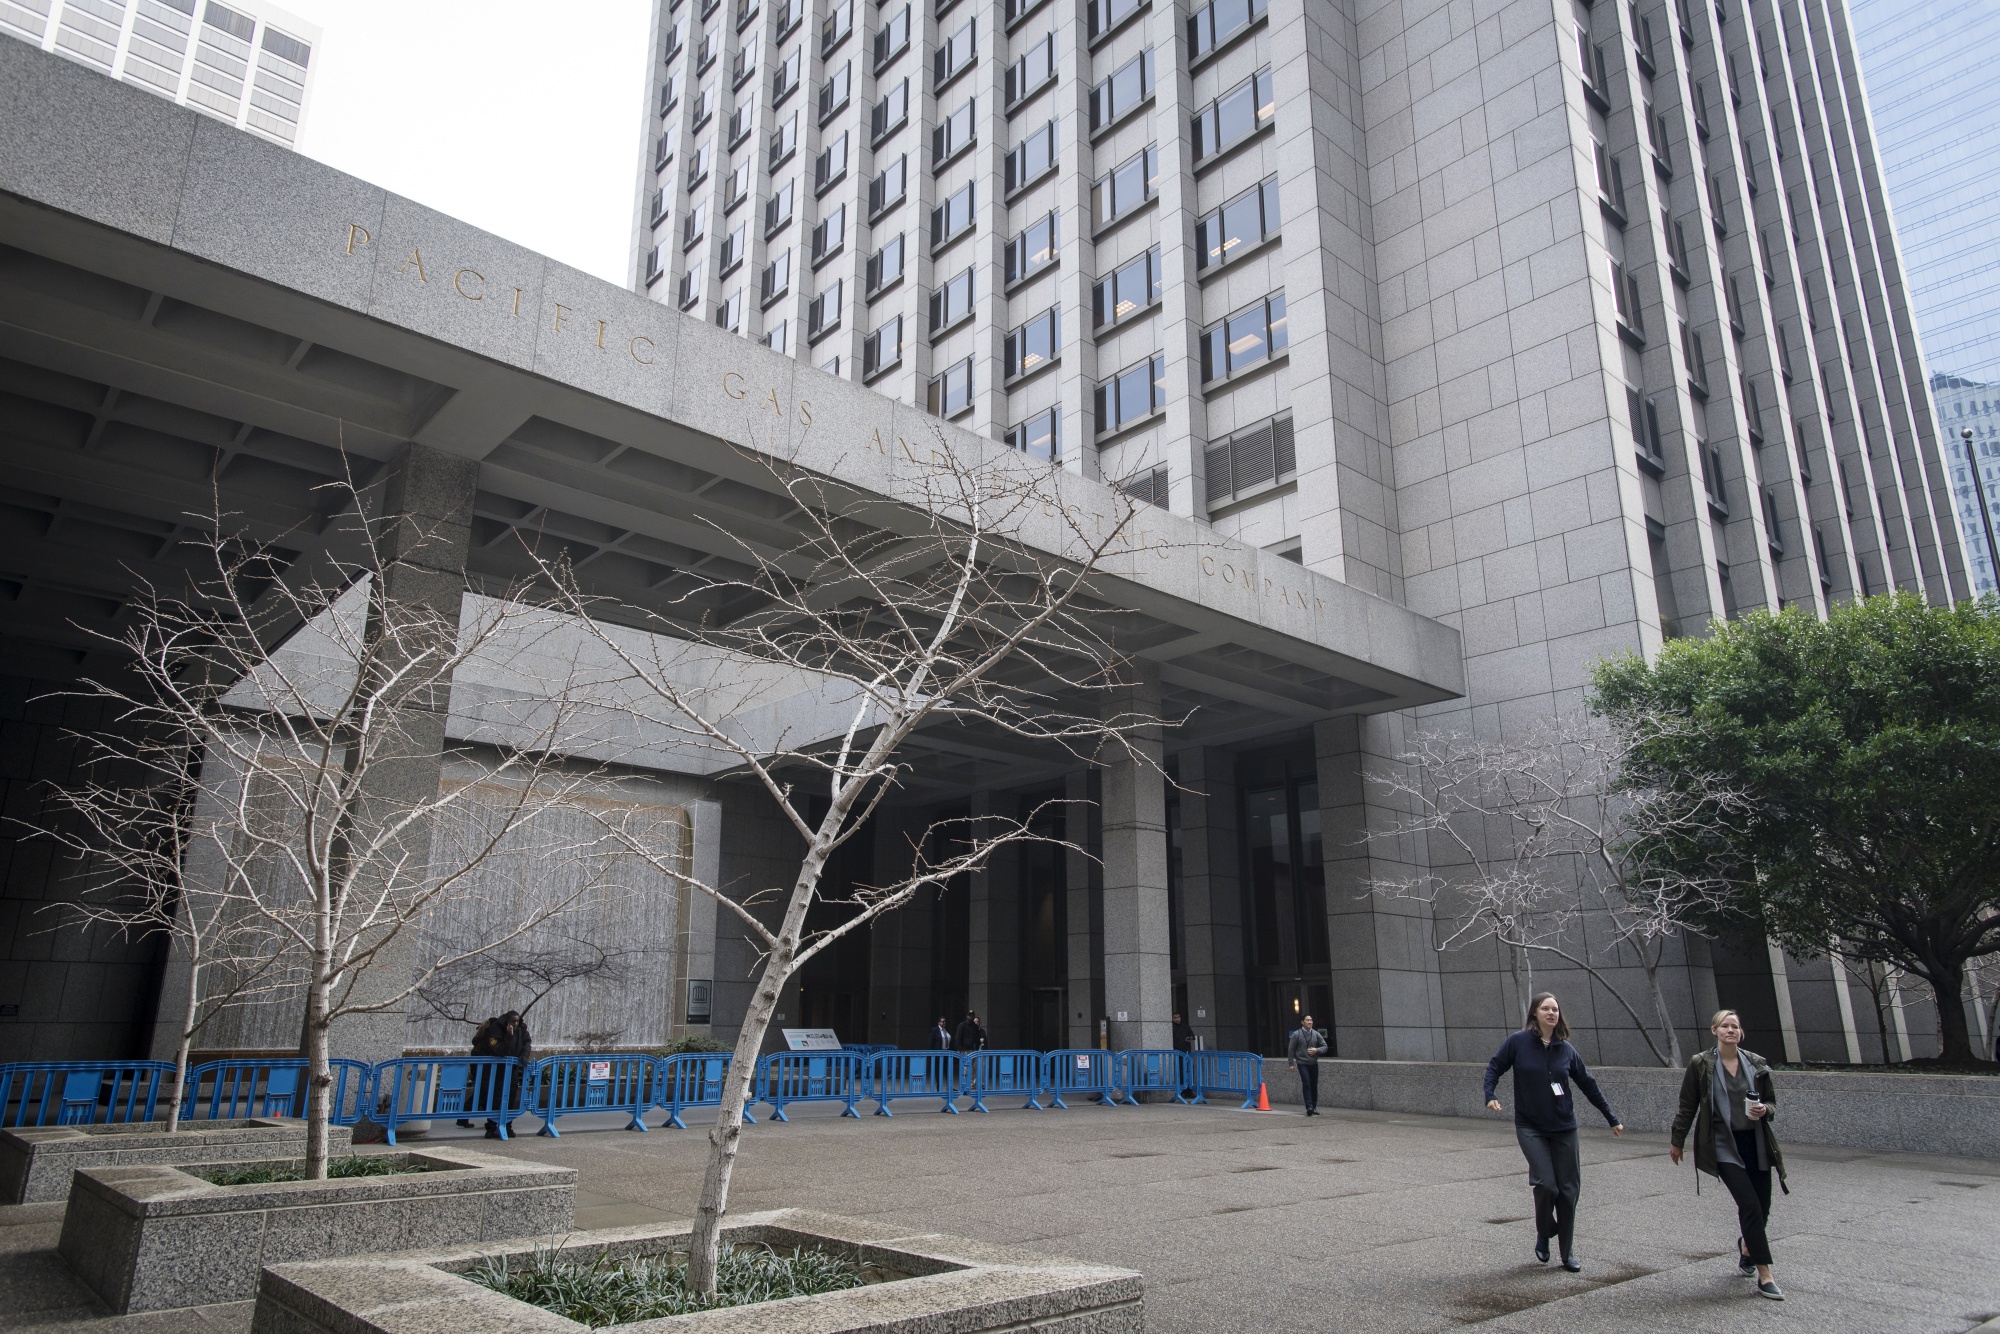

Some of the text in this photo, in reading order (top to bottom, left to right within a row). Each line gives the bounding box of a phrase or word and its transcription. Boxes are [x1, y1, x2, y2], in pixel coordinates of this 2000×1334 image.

[346, 223, 656, 366] PACIFIC
[722, 372, 812, 426] GAS
[865, 427, 951, 476] AND
[1202, 556, 1326, 618] COMPANY
